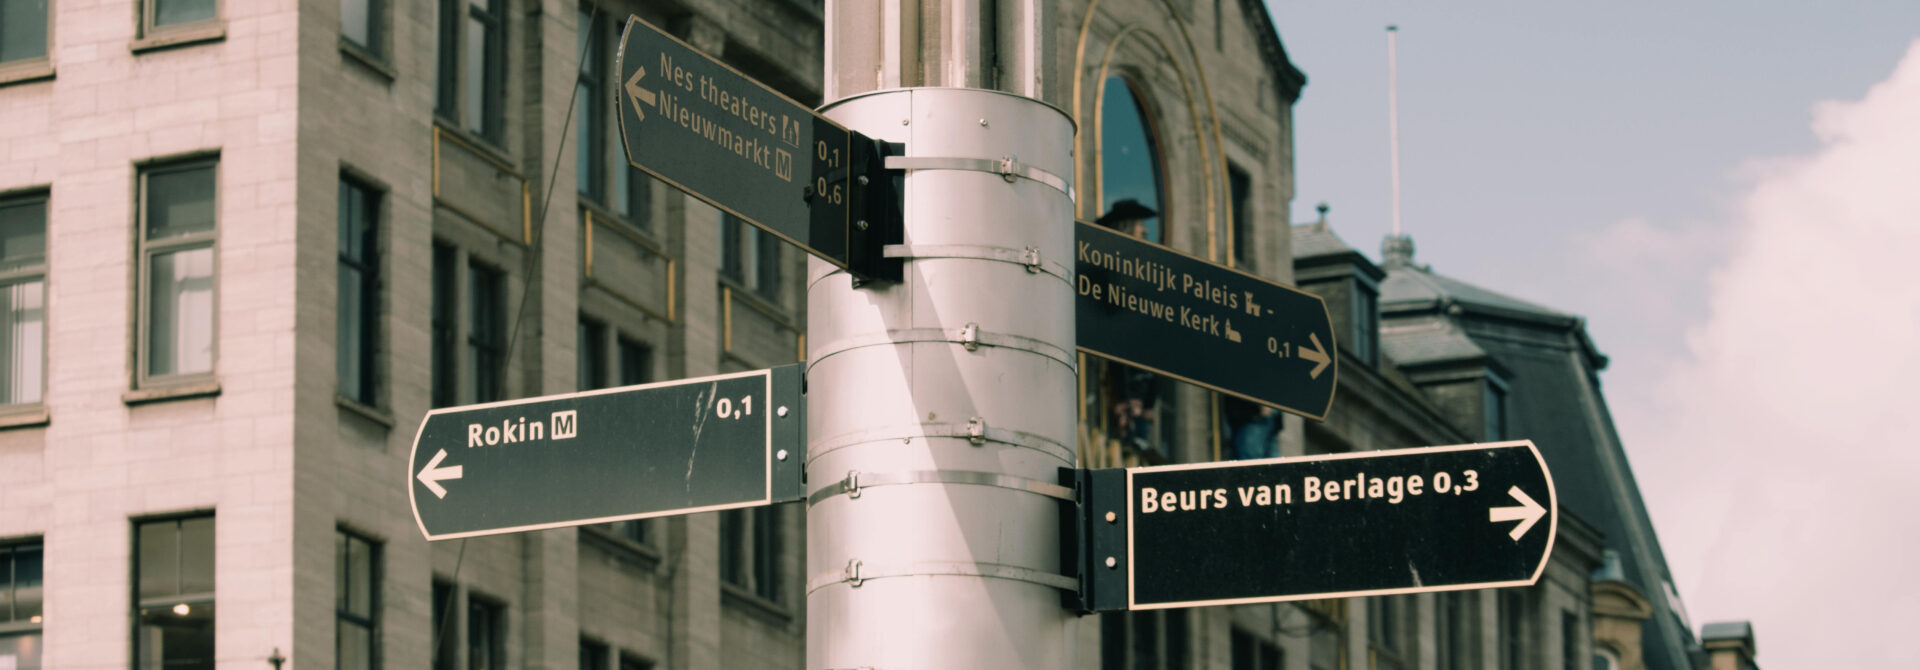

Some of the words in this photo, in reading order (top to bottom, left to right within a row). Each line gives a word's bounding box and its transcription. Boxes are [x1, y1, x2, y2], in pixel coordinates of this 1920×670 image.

[659, 90, 770, 170] Nieuwmarkt
[817, 176, 842, 205] 0,6
[660, 52, 694, 93] Nes
[700, 74, 777, 135] theaters
[817, 140, 839, 168] 0,1
[1078, 240, 1177, 292] Koninklijk
[1183, 273, 1238, 309] Paleis
[1078, 274, 1102, 300] De
[1108, 283, 1174, 323] Nieuwe
[1180, 305, 1220, 337] Kerk
[1267, 336, 1291, 358] 0,1
[467, 415, 544, 448] Rokin
[716, 394, 752, 420] 0,1
[1141, 487, 1228, 514] Beurs
[1238, 484, 1292, 507] van
[1303, 472, 1424, 504] Berlage
[1433, 469, 1480, 497] 0,3
